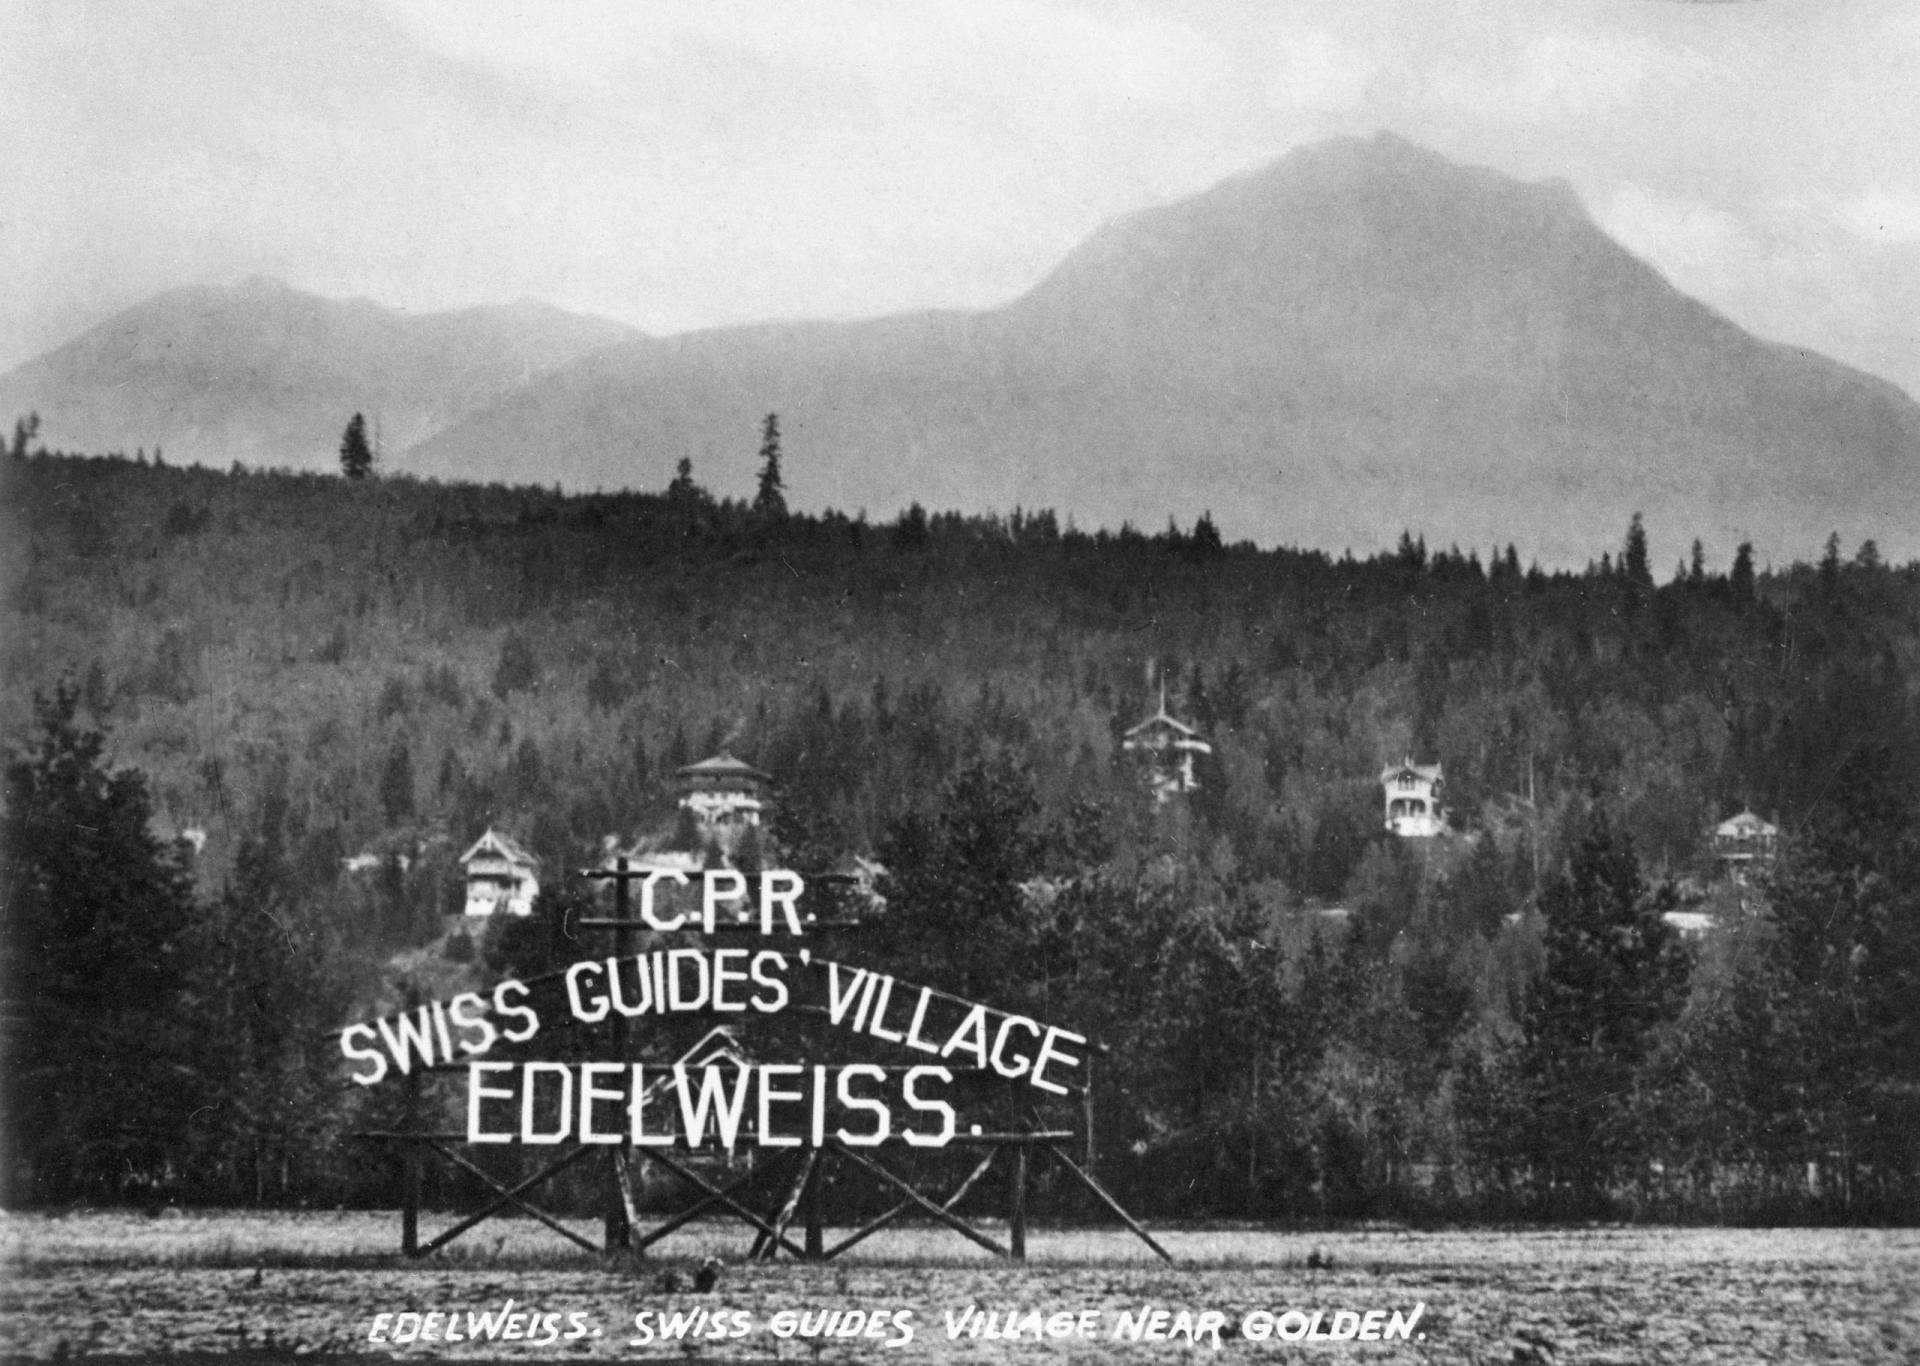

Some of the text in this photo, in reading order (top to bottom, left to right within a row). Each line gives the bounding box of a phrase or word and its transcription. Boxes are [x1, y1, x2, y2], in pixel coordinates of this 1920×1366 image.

[641, 869, 816, 934] C.P.R.
[340, 949, 1087, 1095] SWISS GUIDES' VILLAGE
[467, 1061, 982, 1147] EDELWEISS.
